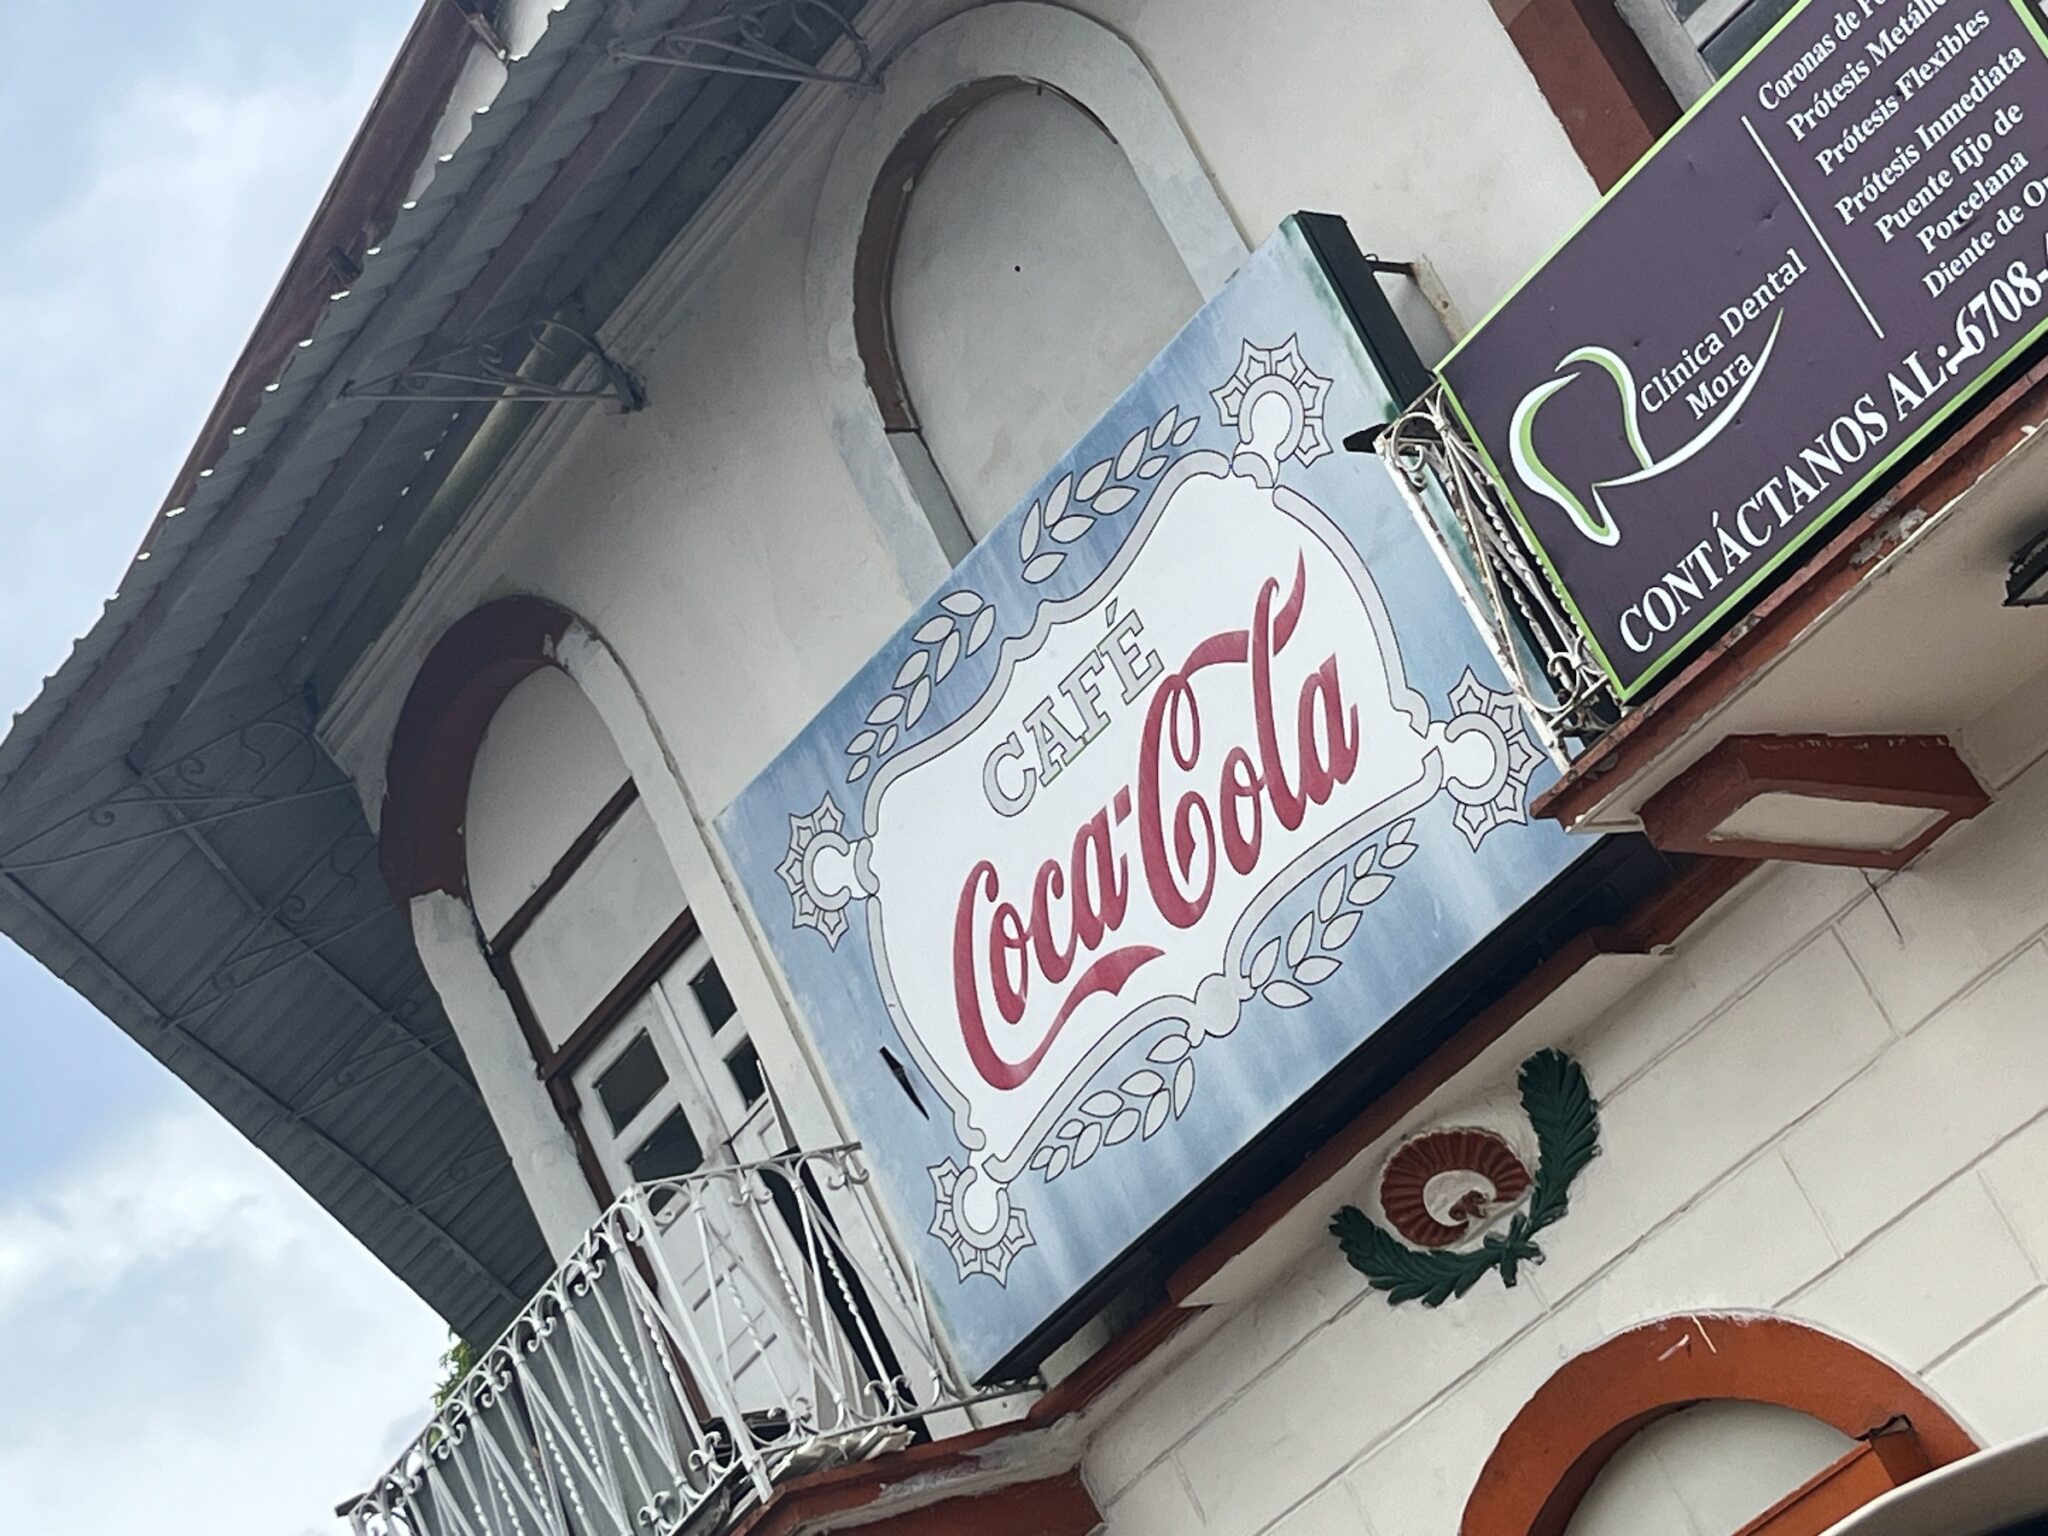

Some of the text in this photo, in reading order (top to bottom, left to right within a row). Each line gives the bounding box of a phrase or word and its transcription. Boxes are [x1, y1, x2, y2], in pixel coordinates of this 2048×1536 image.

[1758, 32, 1837, 110] Coronas
[1833, 12, 1861, 41] de
[1786, 59, 1871, 142] Prótesis
[1815, 9, 1991, 176] Prótesis Flexibles
[1834, 46, 2027, 226] Prótesis Inmediata
[1874, 104, 2024, 243] Puente fijo de
[1916, 151, 2029, 255] Porcelana
[1922, 175, 2048, 298] Diente de O
[1640, 248, 1808, 413] Clínica Dental
[1685, 353, 1755, 420] Mora
[1619, 393, 1888, 653] CONTÁCTANOS
[1955, 231, 2048, 355] 6708-
[982, 596, 1164, 818] CAFÉ
[952, 546, 1360, 1091] Coca-Cola
